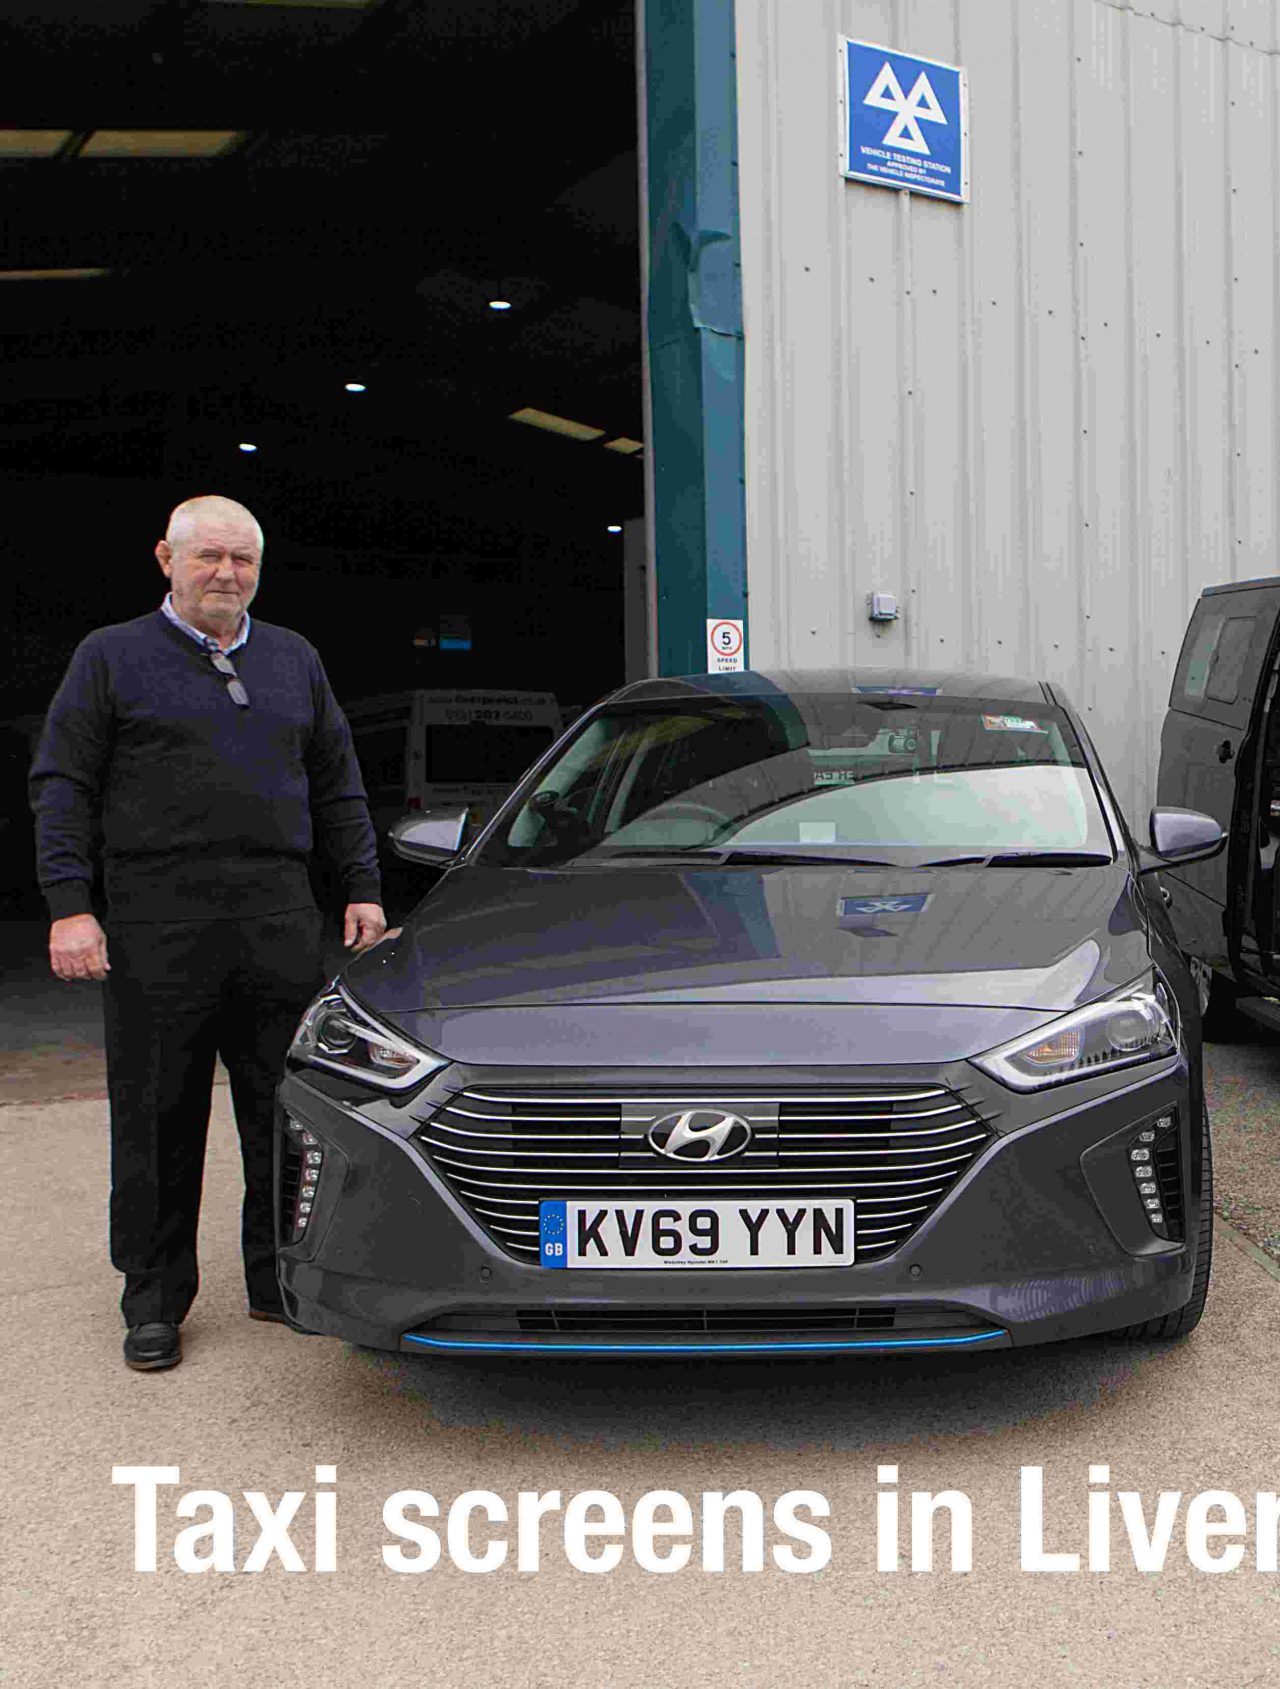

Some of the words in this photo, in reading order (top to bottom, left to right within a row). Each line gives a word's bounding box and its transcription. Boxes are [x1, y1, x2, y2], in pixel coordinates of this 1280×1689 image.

[860, 145, 892, 159] VEHICLE
[893, 152, 922, 167] TESTING
[923, 160, 951, 174] STATION
[722, 632, 731, 645] 5
[577, 1208, 719, 1257] KV69
[738, 1207, 844, 1256] YYN
[545, 1243, 563, 1257] GB
